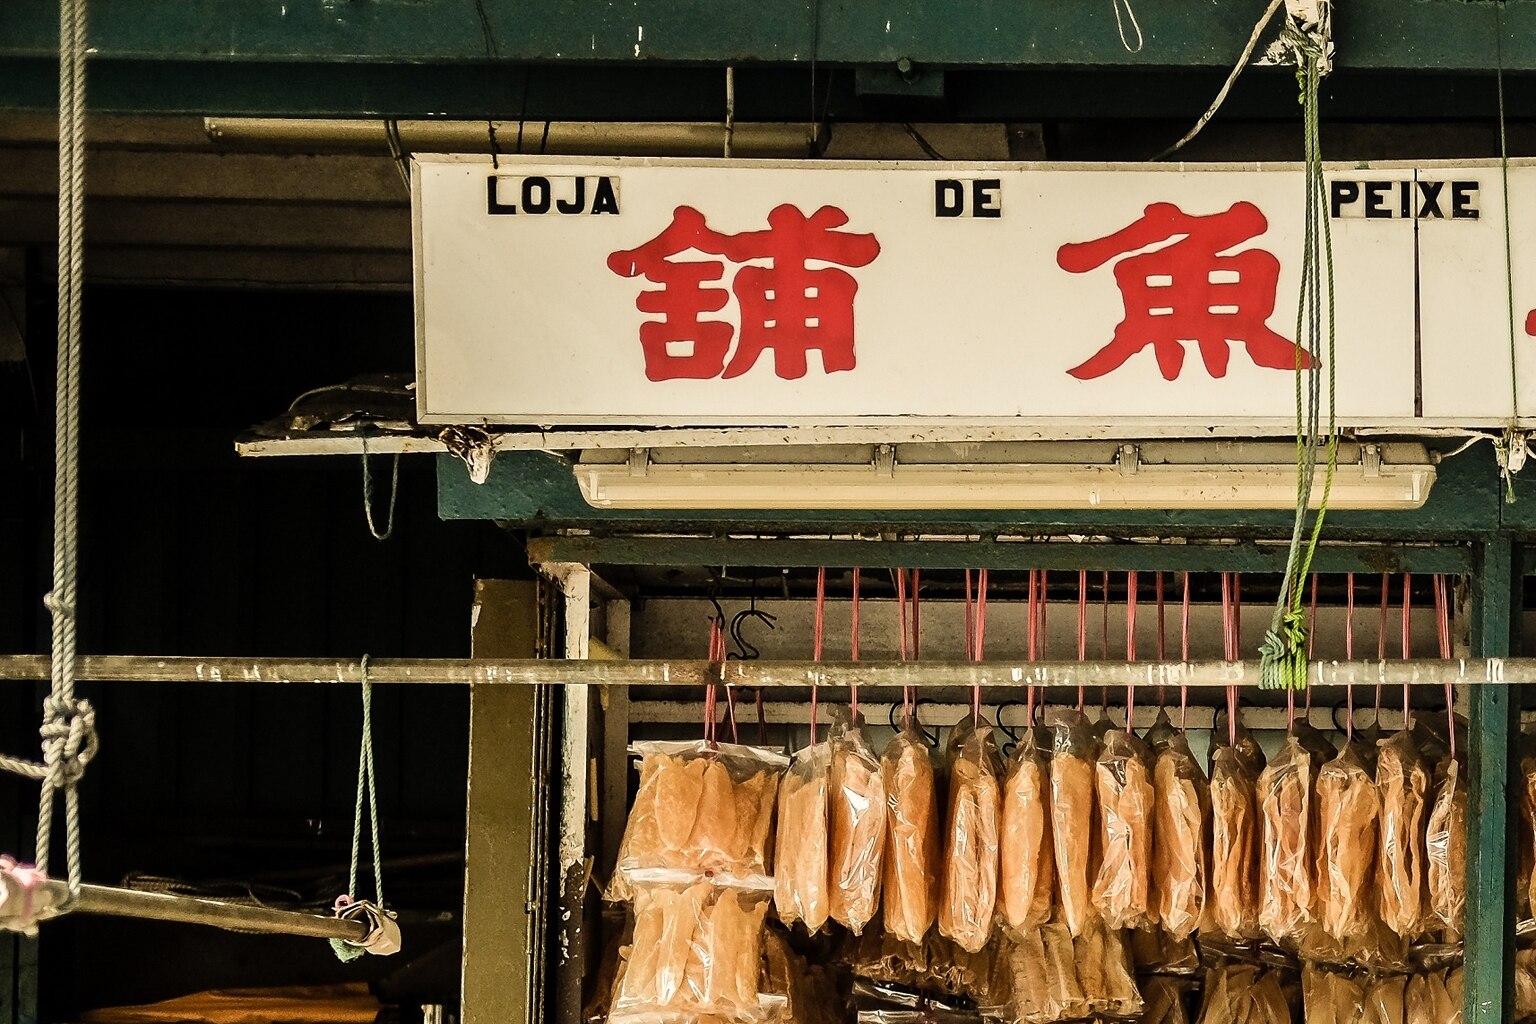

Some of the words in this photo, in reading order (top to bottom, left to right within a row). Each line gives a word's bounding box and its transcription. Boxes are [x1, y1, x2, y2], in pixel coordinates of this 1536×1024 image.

[487, 175, 620, 215] LOJA
[935, 178, 1001, 217] DE
[1330, 179, 1481, 218] PEIXE
